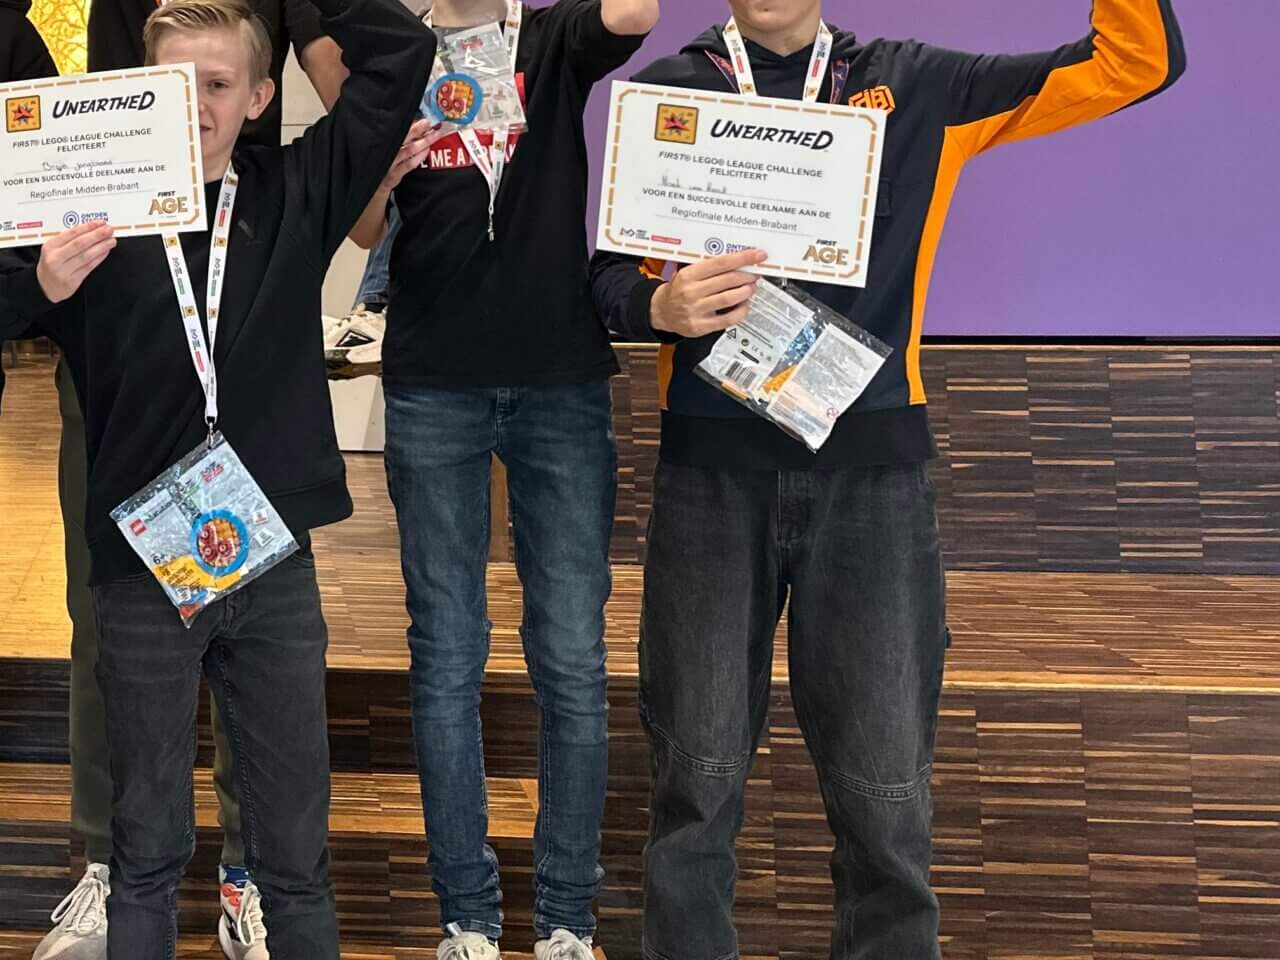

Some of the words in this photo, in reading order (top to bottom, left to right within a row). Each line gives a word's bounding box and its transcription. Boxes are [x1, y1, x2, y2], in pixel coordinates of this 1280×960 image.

[52, 90, 155, 119] UNEARTHED
[70, 133, 102, 143] LEAGUE
[103, 128, 152, 139] CHALLENGE
[710, 119, 834, 150] UNEARTHED
[57, 141, 106, 153] FELICITEERT
[430, 148, 452, 167] ME
[456, 147, 466, 165] A
[3, 178, 23, 186] VOOR
[41, 171, 94, 182] SUCCESVOLLE
[96, 167, 135, 177] DEELNAME
[155, 164, 165, 172] DE
[710, 167, 768, 180] FELICITEERT
[726, 160, 764, 171] LEAGUE
[766, 164, 822, 178] CHALLENGE
[30, 188, 74, 200] Regiofinale
[75, 182, 139, 194] Midden-Brabant
[148, 196, 188, 216] AGE
[642, 189, 666, 198] VOOR
[668, 192, 685, 200] EEN
[687, 194, 748, 208] SUCCESVOLLE
[750, 202, 796, 214] DEELNAME
[798, 209, 817, 217] AAN
[818, 211, 830, 219] DE
[671, 206, 722, 221] Regiofinale
[724, 213, 797, 231] Midden-Brabant
[802, 245, 850, 266] AGE
